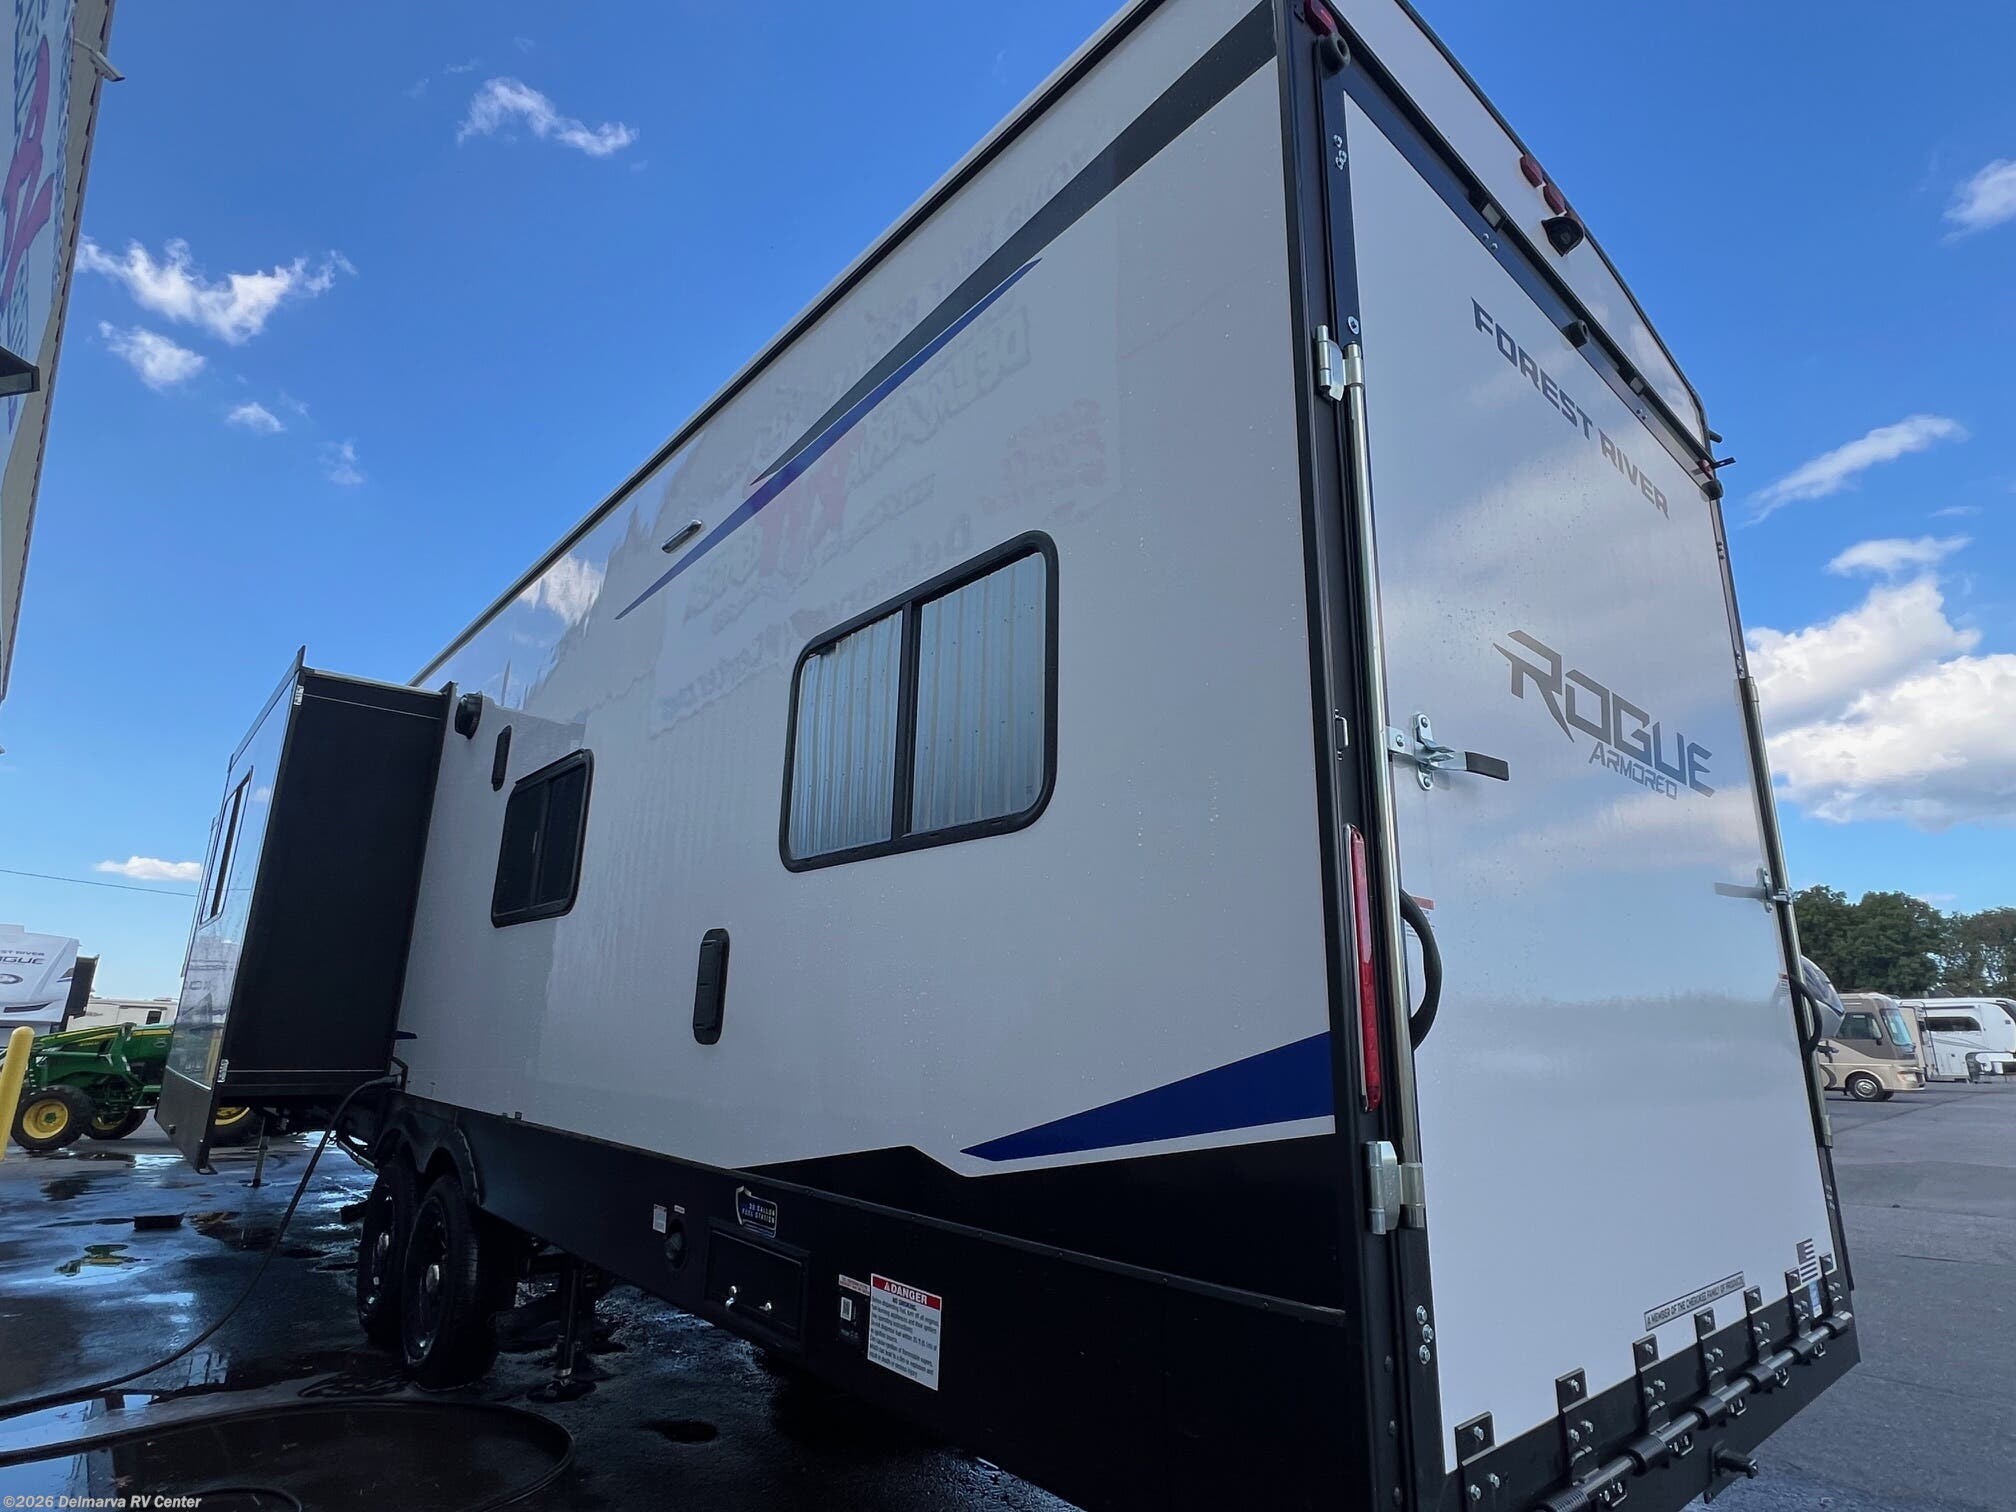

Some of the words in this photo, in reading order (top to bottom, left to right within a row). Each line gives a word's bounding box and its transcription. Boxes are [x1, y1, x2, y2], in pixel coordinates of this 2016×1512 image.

[1470, 296, 1593, 441] FOREST
[1598, 428, 1671, 520] RIVER
[1493, 629, 1716, 798] ROGUE
[1588, 741, 1677, 800] ARMORED
[890, 1283, 928, 1305] DANGER
